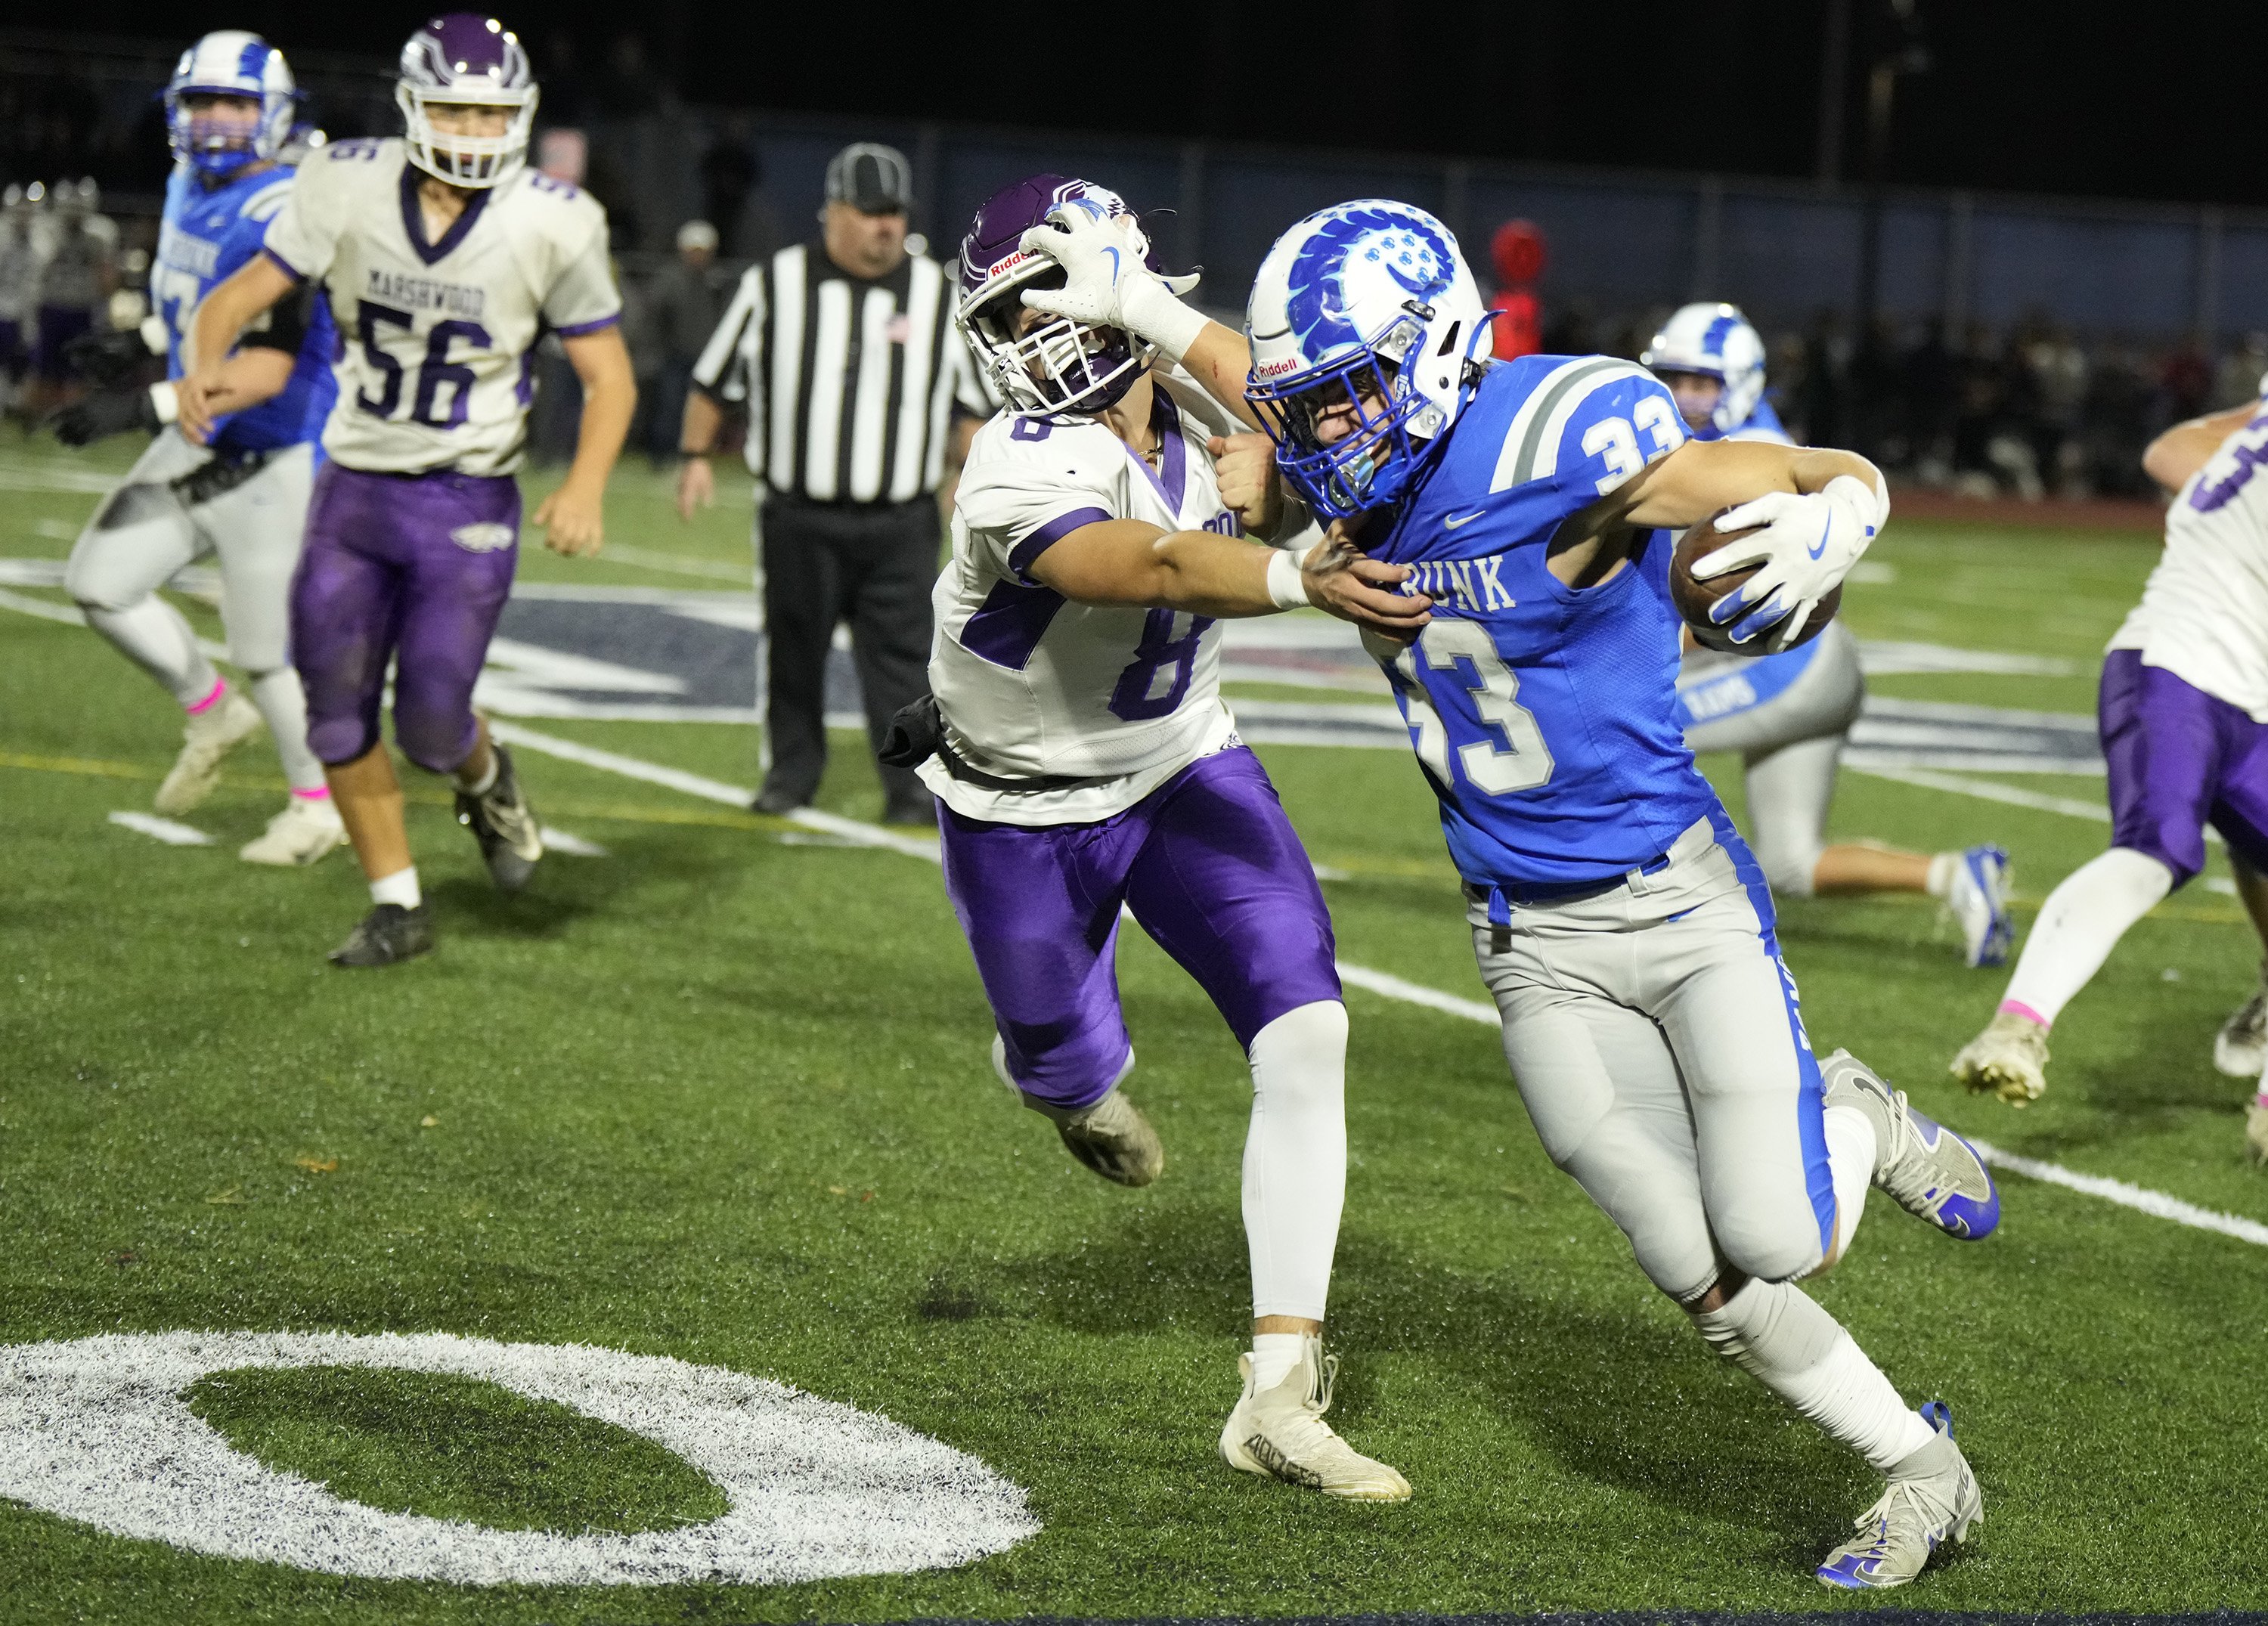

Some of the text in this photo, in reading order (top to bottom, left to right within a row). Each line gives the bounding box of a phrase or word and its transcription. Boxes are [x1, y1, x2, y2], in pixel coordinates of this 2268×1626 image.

[355, 297, 493, 431] 56
[1259, 358, 1297, 378] Riddell
[1581, 395, 1685, 497] 33
[1108, 606, 1216, 721] 8
